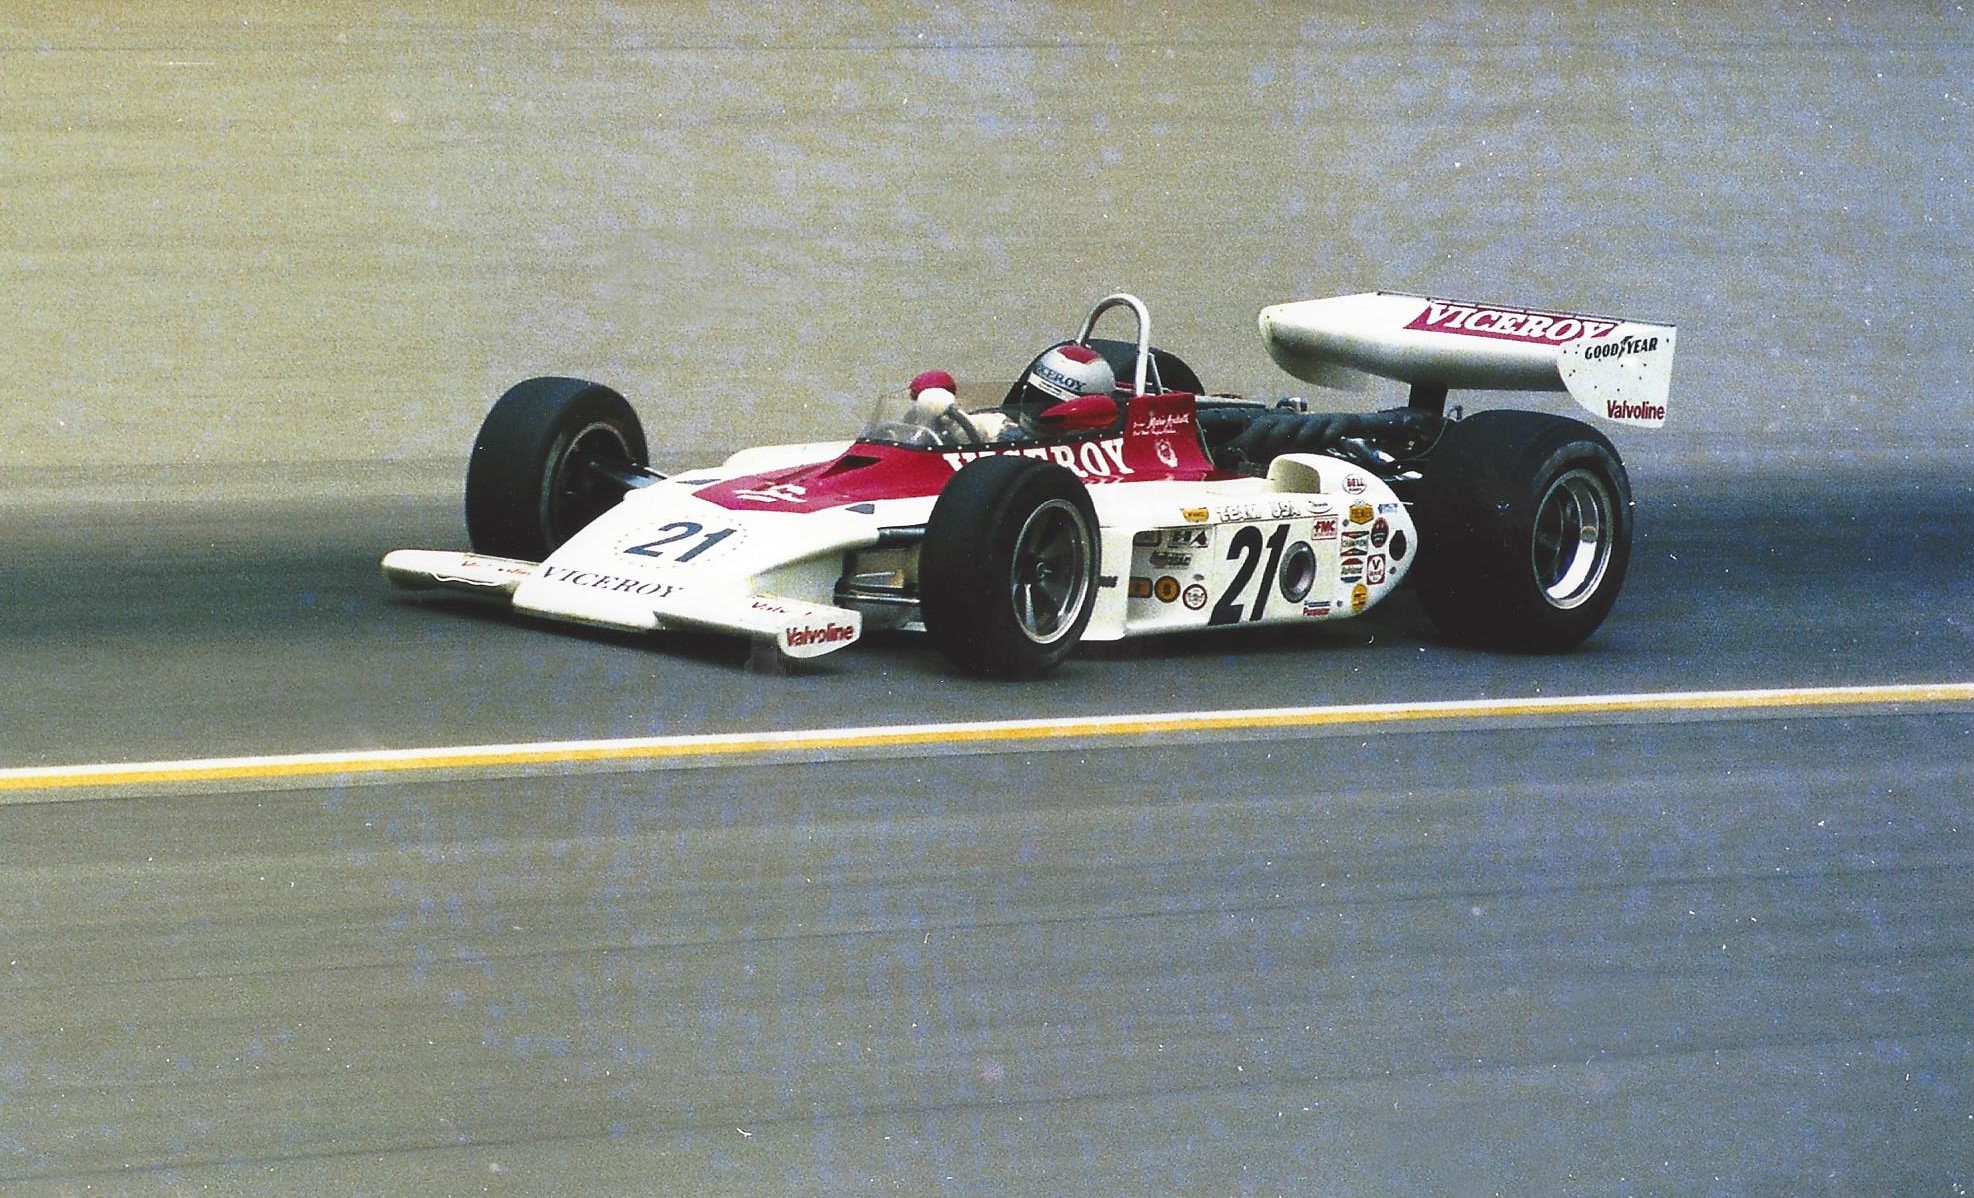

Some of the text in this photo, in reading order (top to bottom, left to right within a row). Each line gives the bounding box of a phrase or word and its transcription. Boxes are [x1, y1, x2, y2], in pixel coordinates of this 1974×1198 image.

[1426, 303, 1617, 341] VICEROY
[1585, 336, 1658, 359] GOODYEAR
[1607, 400, 1665, 419] Valvoline
[1346, 478, 1365, 487] BELL
[623, 521, 737, 562] 21
[543, 566, 685, 597] VICEROY
[1207, 523, 1291, 626] 21
[786, 623, 854, 646] Valvoline
